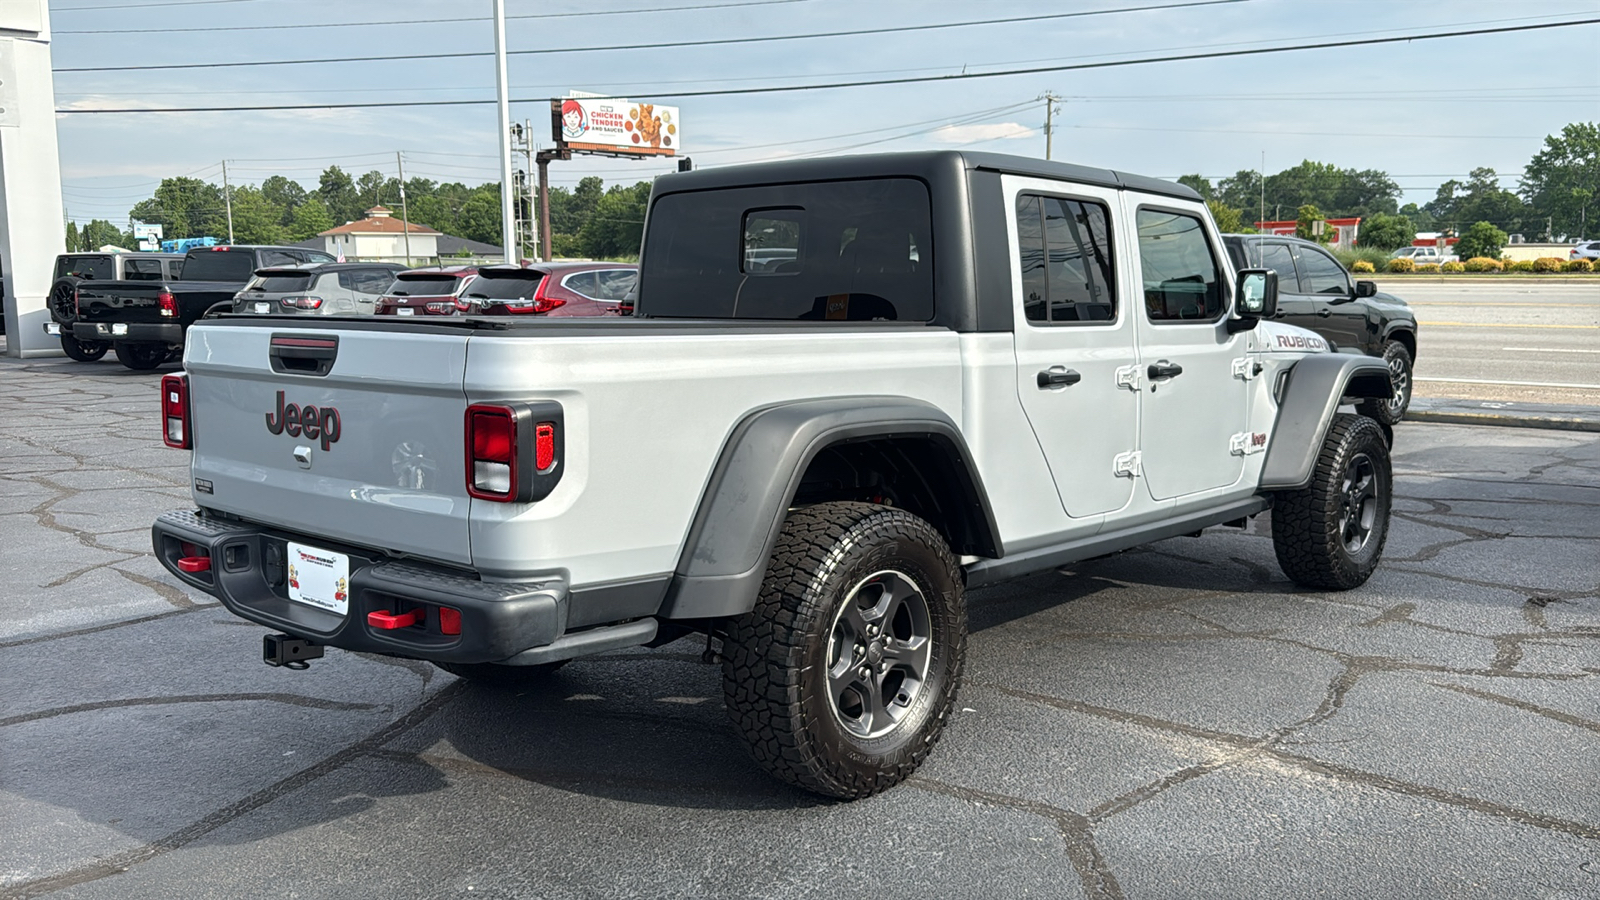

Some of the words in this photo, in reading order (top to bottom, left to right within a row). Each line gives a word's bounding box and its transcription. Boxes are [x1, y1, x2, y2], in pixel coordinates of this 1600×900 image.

[591, 111, 623, 120] CHICKEN
[591, 119, 623, 127] TENDERS
[1276, 335, 1327, 349] RUBICON
[265, 389, 341, 451] Jeep
